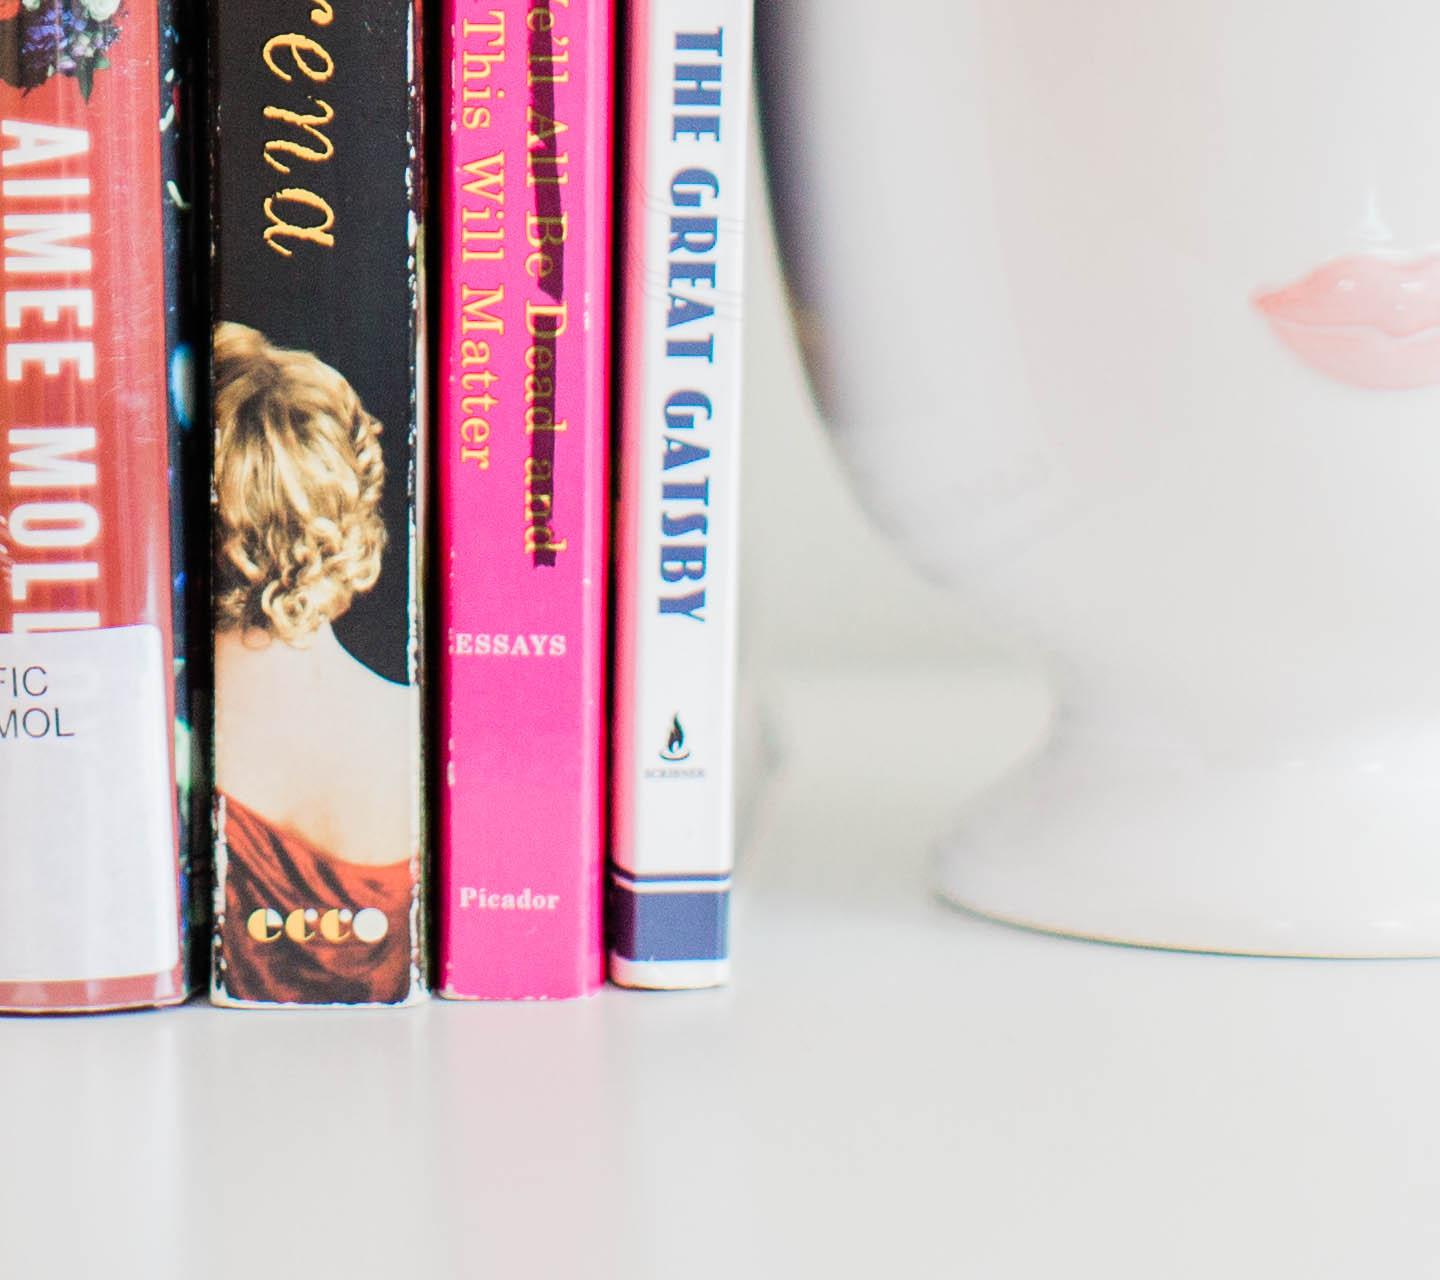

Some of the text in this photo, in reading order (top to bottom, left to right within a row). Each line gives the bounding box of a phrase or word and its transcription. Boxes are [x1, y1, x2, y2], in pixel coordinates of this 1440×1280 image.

[462, 12, 505, 130] This
[461, 152, 504, 263] Will
[525, 212, 568, 278] Be
[0, 120, 101, 633] AIMEE MOLL
[461, 283, 504, 470] Matter
[525, 300, 568, 433] Dead
[657, 26, 724, 623] THE GREAT GATSBY
[524, 458, 567, 553] and
[455, 633, 566, 656] ESSAYS
[247, 907, 389, 943] ecco
[459, 888, 560, 911] Picador
